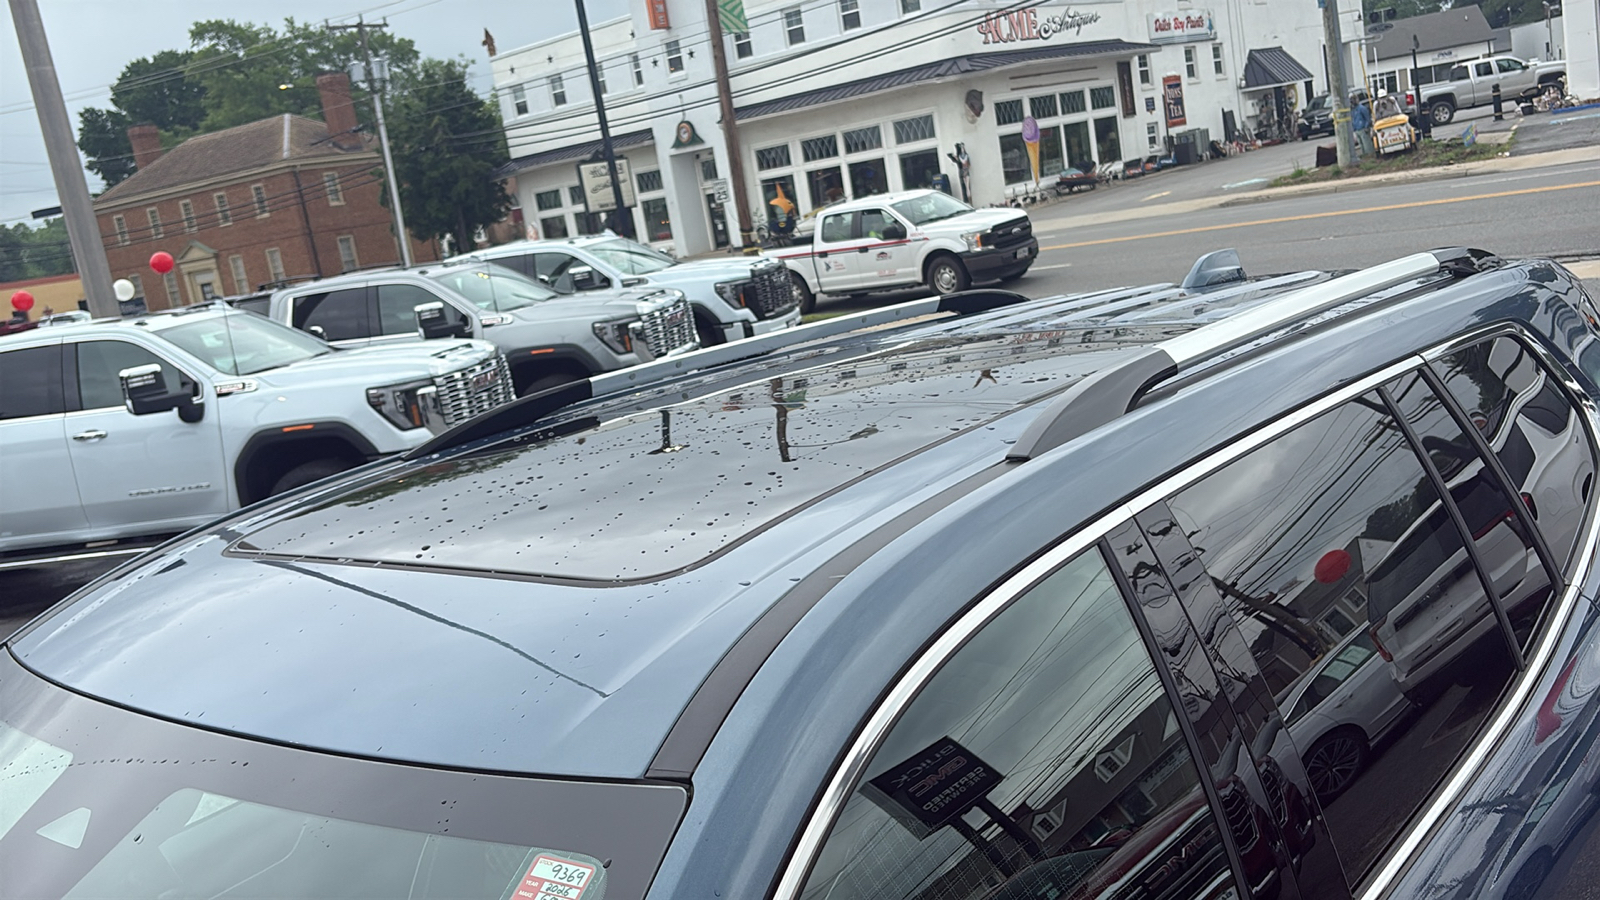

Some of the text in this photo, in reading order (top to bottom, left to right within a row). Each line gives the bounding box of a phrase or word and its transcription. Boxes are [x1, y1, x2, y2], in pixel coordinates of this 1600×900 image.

[977, 9, 1040, 44] ACME
[1058, 5, 1101, 36] Antiques
[1154, 15, 1204, 33] Dutch Boy Paints
[1169, 104, 1183, 118] TEA
[716, 190, 728, 201] 25
[552, 864, 586, 885] 9369
[525, 879, 539, 888] YEAR
[546, 883, 572, 897] 2026
[518, 890, 534, 899] MAKE
